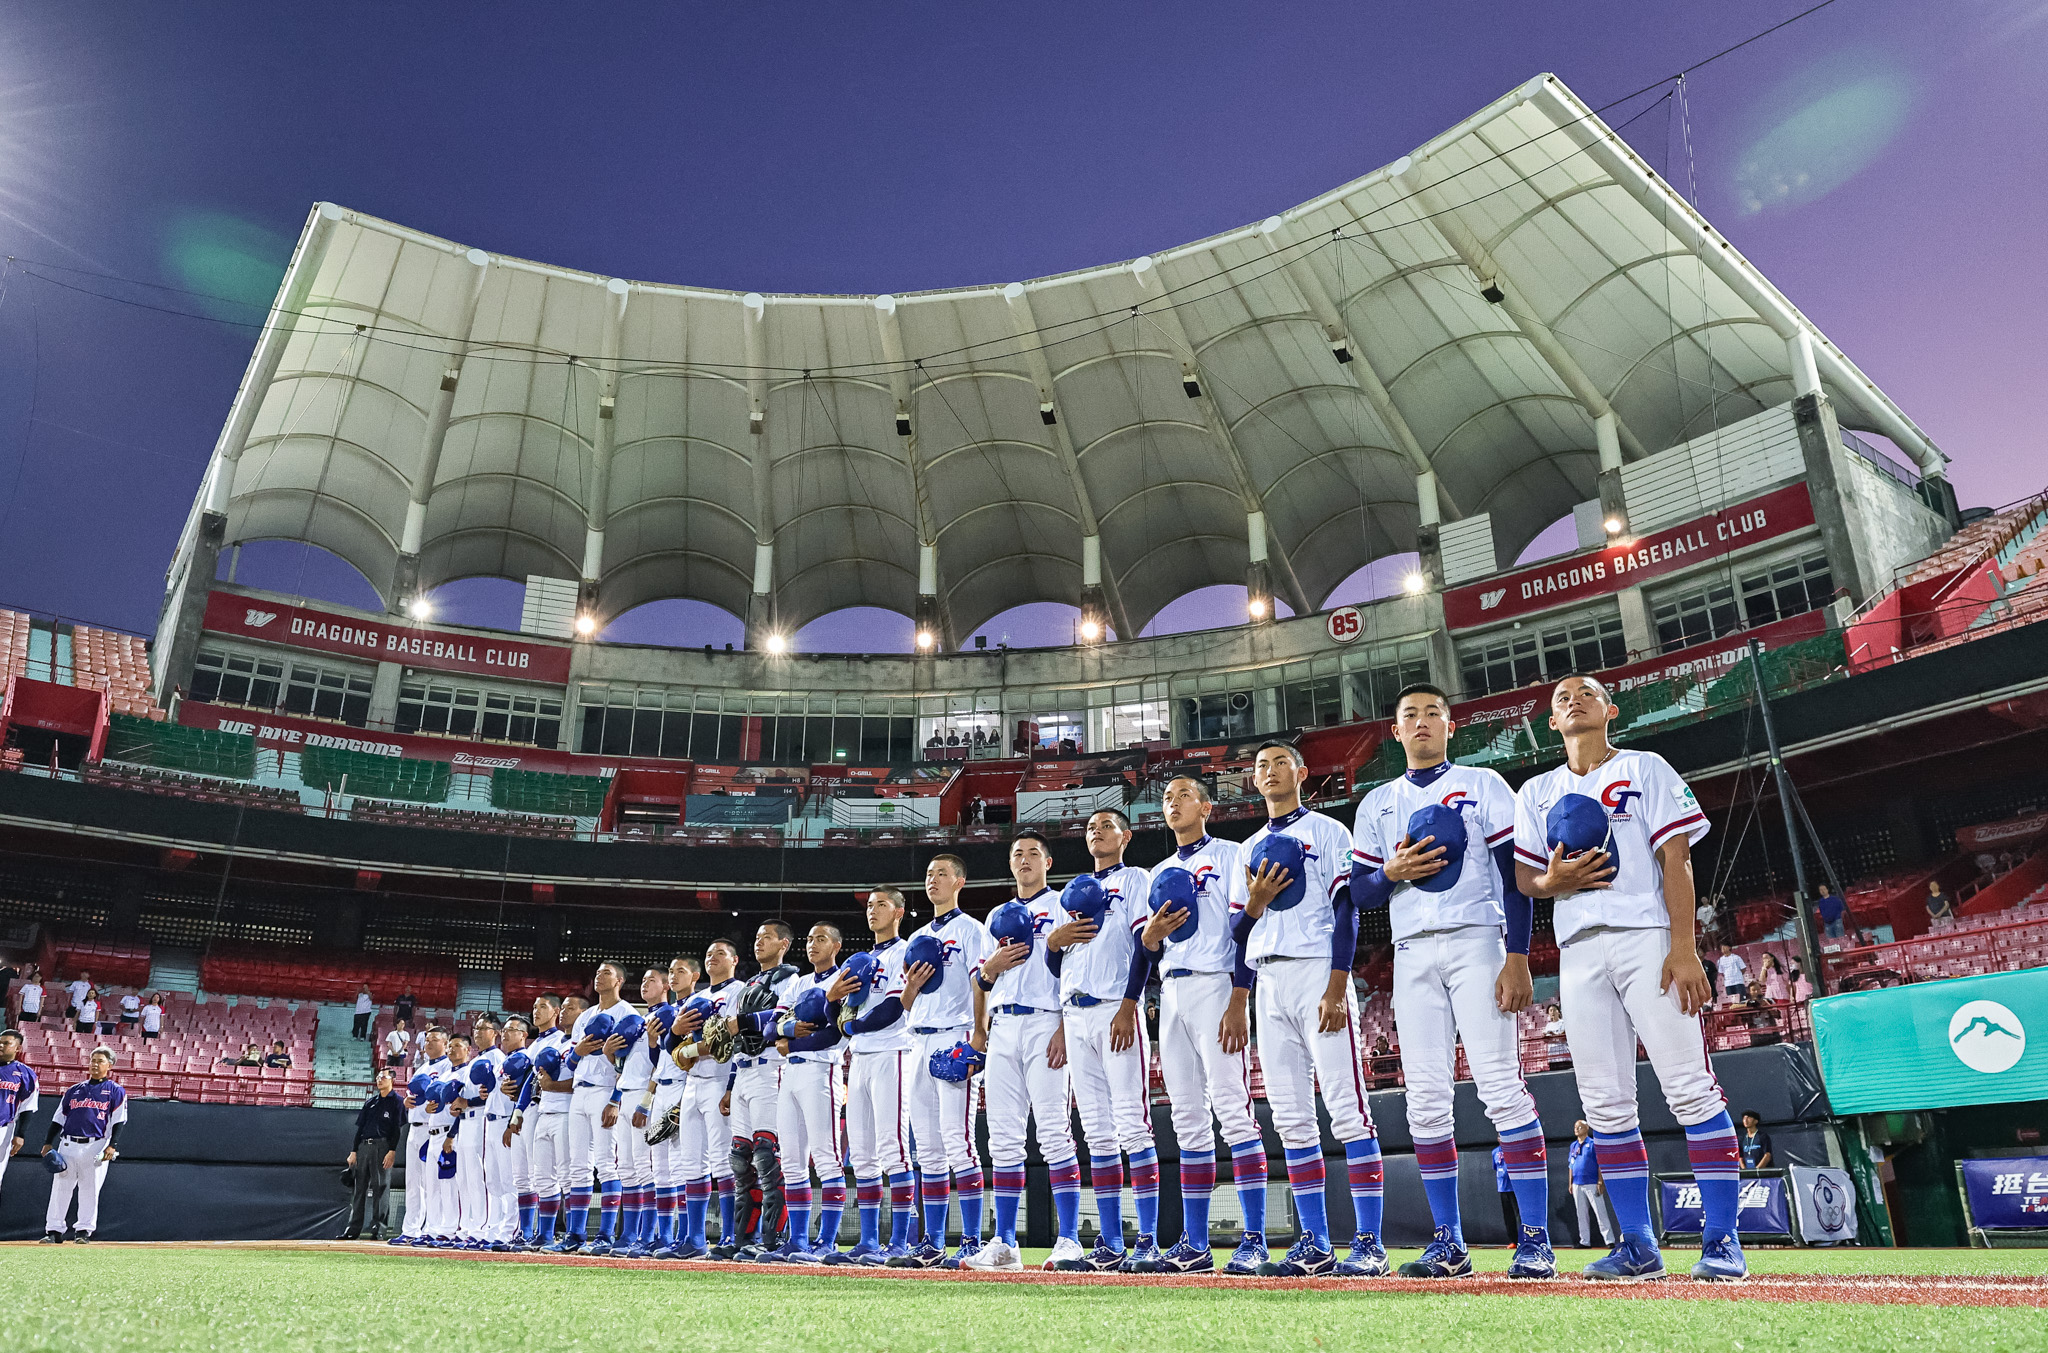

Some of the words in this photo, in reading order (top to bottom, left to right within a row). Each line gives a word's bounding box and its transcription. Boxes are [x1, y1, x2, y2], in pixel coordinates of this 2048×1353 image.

[1521, 562, 1606, 600] DRAGONS
[1613, 530, 1709, 575] BASEBALL
[1716, 509, 1767, 542] CLUB
[1332, 612, 1358, 636] 85
[291, 617, 379, 648] DRAGONS
[386, 635, 477, 662] BASEBALL
[485, 649, 530, 669] CLUB
[218, 719, 256, 737] WE
[304, 732, 403, 758] DRAGONS
[452, 752, 521, 769] DRAGONS
[698, 767, 721, 775] O-GRILL
[69, 1098, 110, 1110] Thailand
